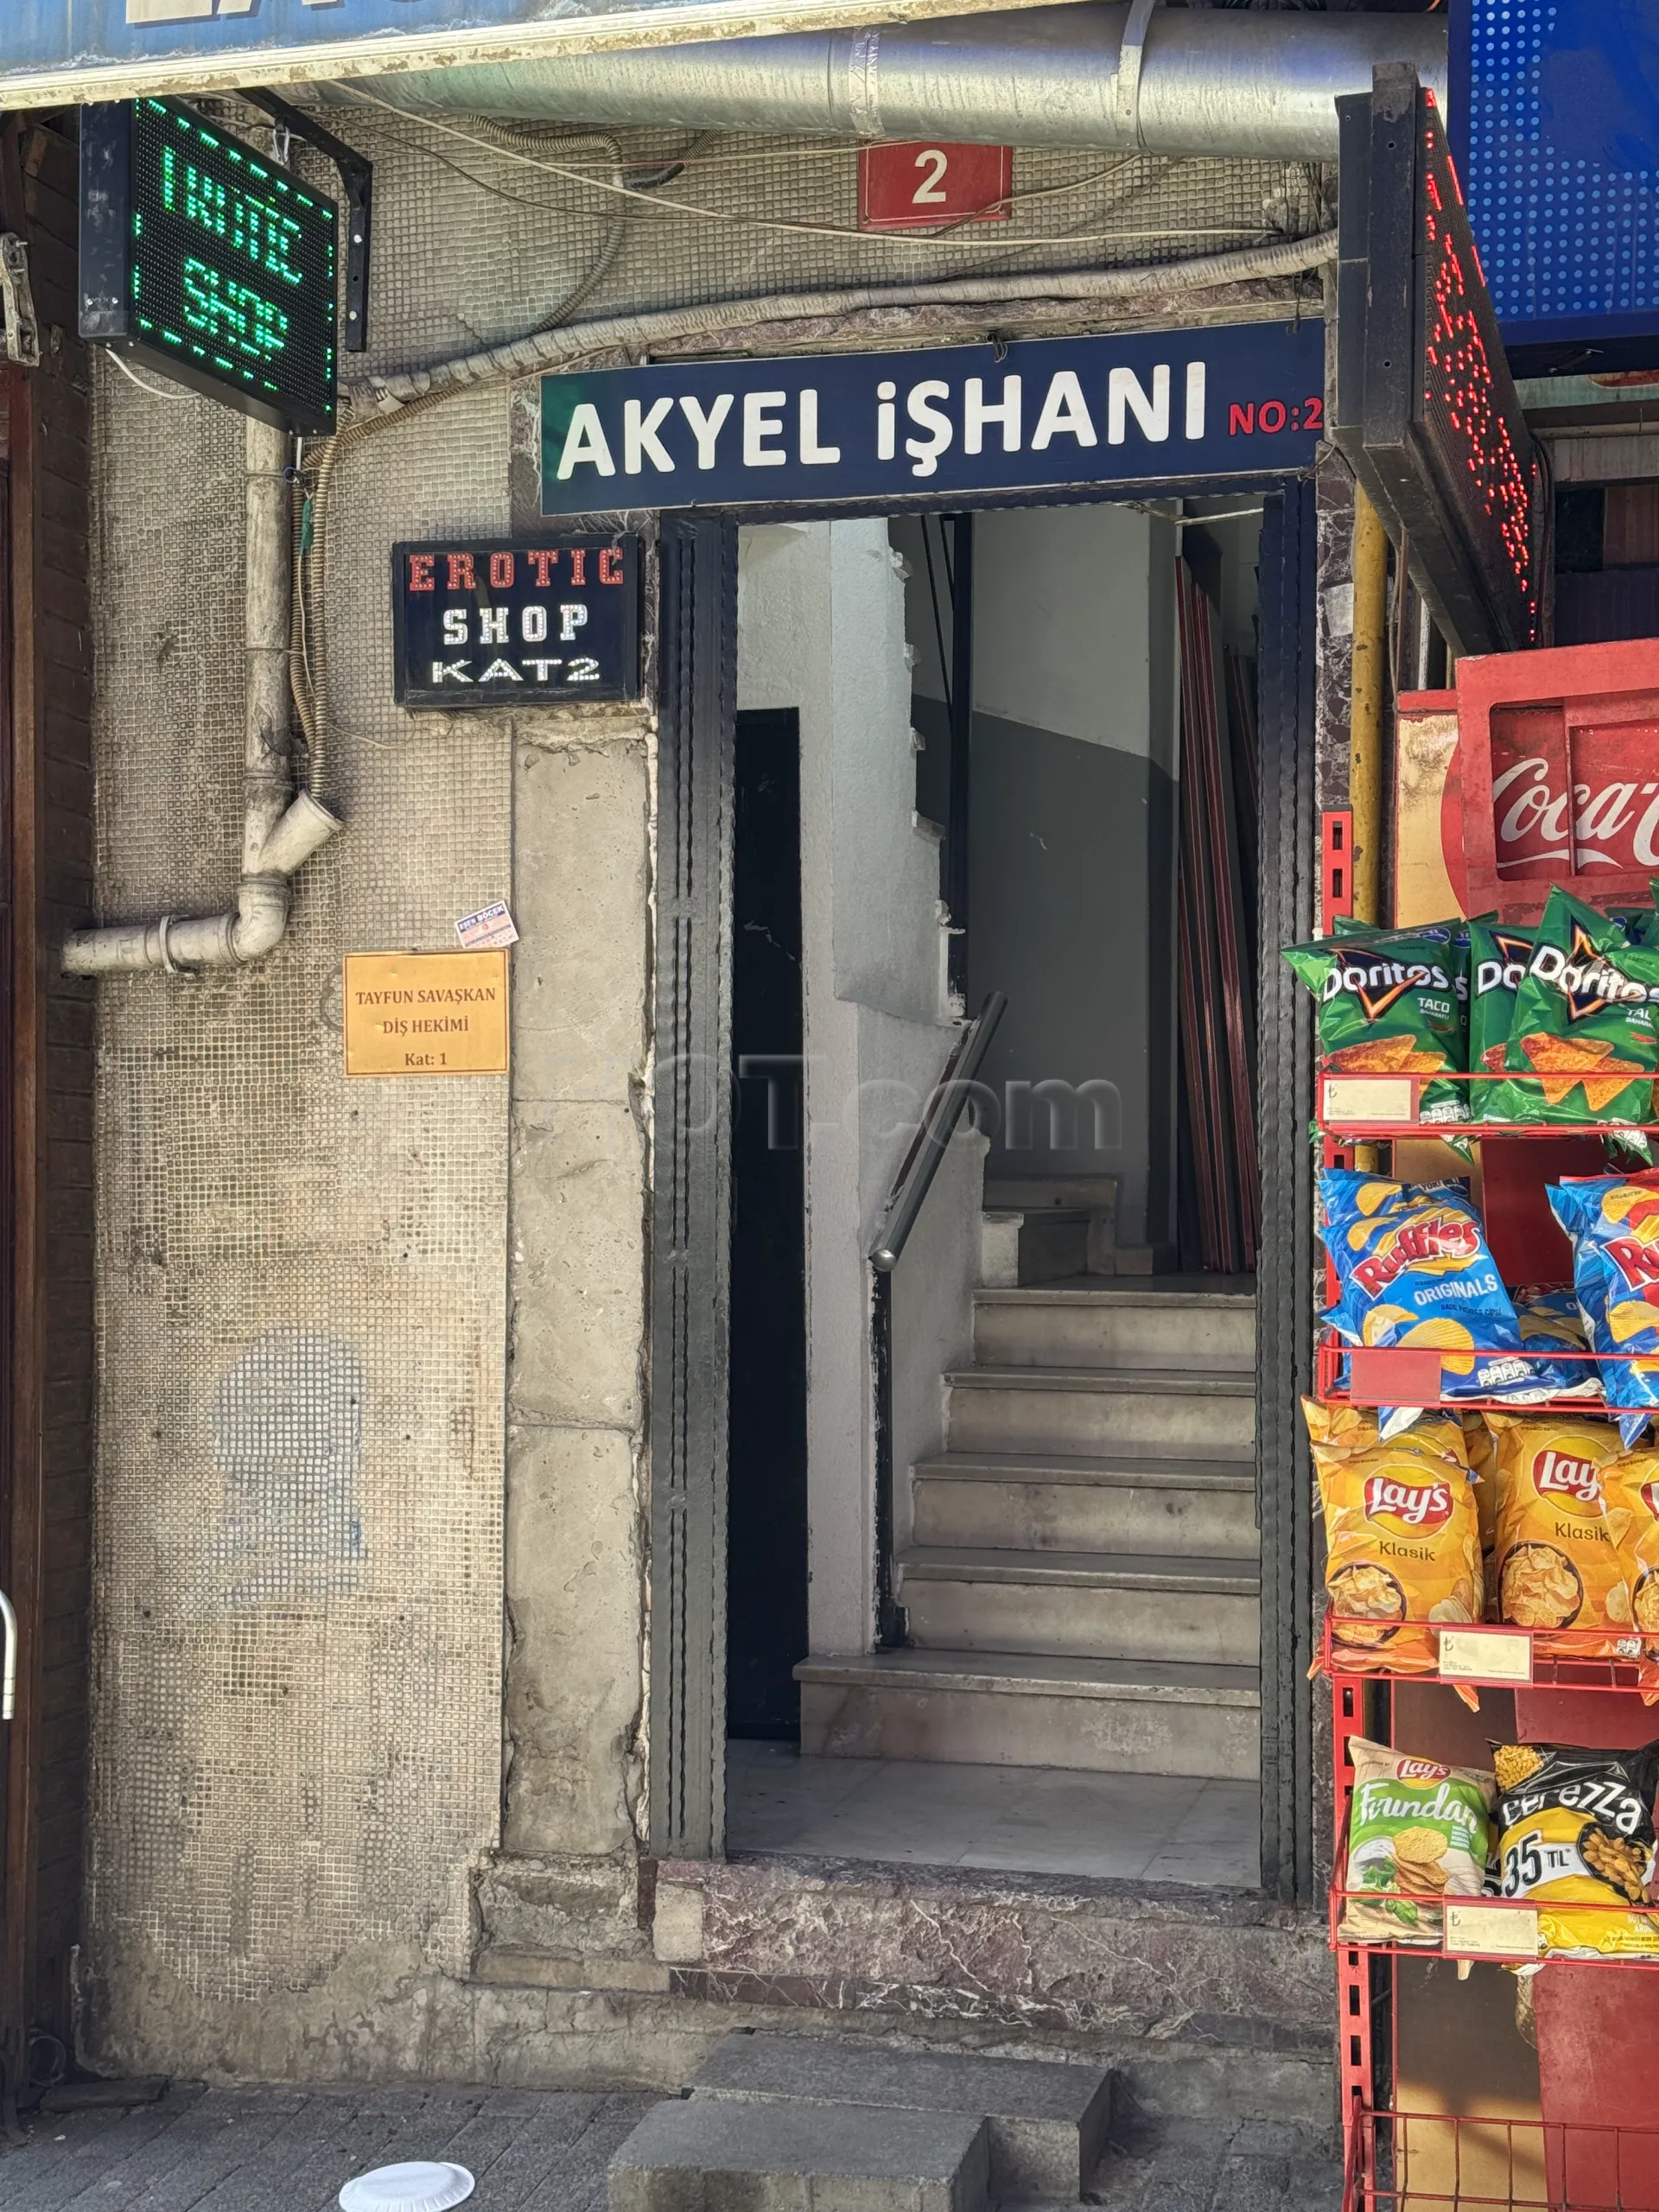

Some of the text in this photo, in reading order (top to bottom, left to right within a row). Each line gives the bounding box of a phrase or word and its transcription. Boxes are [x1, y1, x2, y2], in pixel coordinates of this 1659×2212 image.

[911, 149, 949, 204] 2
[556, 388, 841, 480] AKYEL
[1229, 397, 1324, 436] NO:2
[409, 548, 624, 591] EROTIC
[442, 604, 588, 645] SHOP
[356, 988, 496, 1005] TAYFUN SAVAŞKAN
[1323, 963, 1450, 1002] Doritos
[1417, 997, 1450, 1014] TACO
[383, 1015, 469, 1036] DİŞ HEKİMİ
[404, 1052, 448, 1066] Kat: 1
[1349, 1216, 1481, 1301] Ruffles
[1414, 1273, 1499, 1306] ORIGINALS
[1539, 1451, 1600, 1502] Lay
[1369, 1478, 1449, 1524] Lay's
[1379, 1541, 1436, 1561] Klasik
[1555, 1522, 1611, 1542] Klasik
[1399, 1759, 1448, 1780] Lay's
[1504, 1832, 1542, 1897] 35
